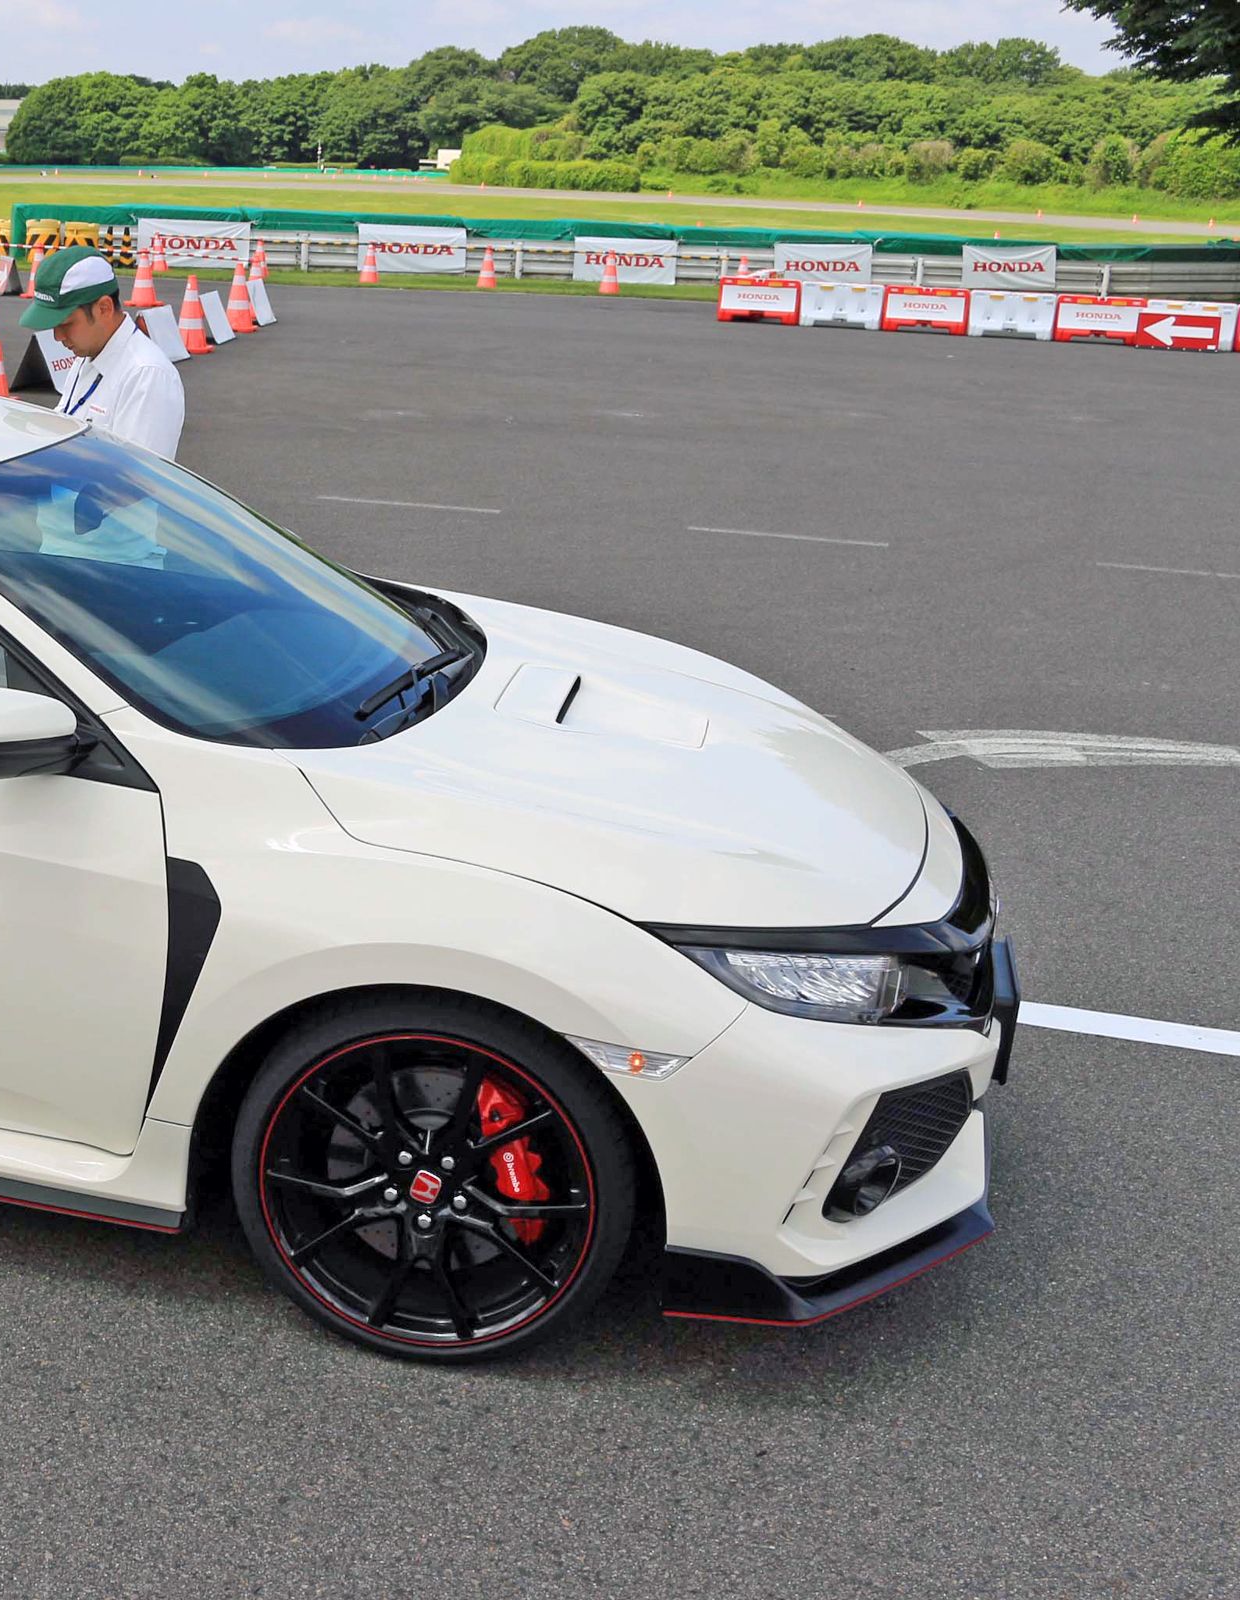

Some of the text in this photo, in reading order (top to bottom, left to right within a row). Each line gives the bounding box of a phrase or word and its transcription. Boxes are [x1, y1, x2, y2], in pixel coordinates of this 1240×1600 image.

[784, 260, 861, 272] HONDA
[972, 260, 1046, 273] HONDA
[737, 292, 781, 301] HONDA
[903, 301, 948, 310] HONDA
[1075, 311, 1123, 320] HONDA
[52, 356, 76, 371] HON
[506, 1162, 520, 1193] brembo
